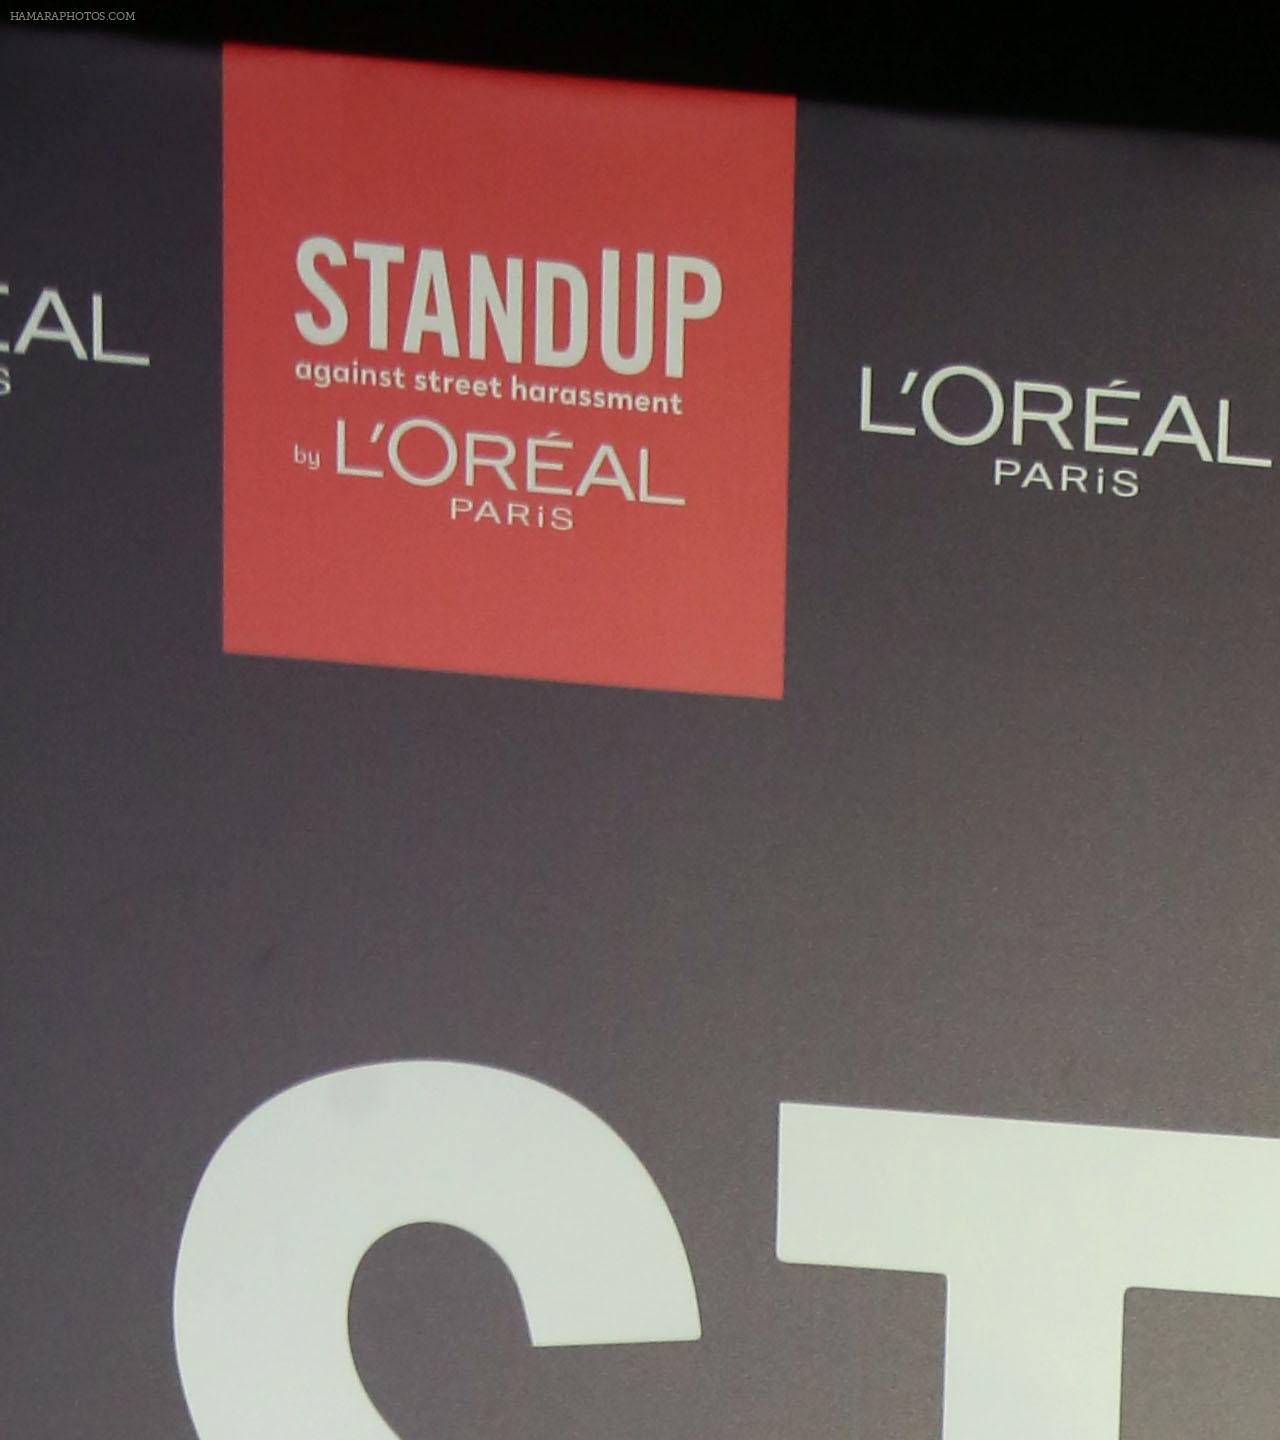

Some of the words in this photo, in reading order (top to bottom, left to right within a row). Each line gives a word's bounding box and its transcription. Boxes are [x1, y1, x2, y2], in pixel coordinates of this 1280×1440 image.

[293, 234, 724, 381] STANDUP
[293, 359, 407, 390] against
[413, 369, 504, 400] street
[510, 373, 684, 417] harassment
[859, 363, 1274, 470] L'ORÉAL
[292, 442, 322, 472] by
[335, 416, 687, 507] L'ORÉAL
